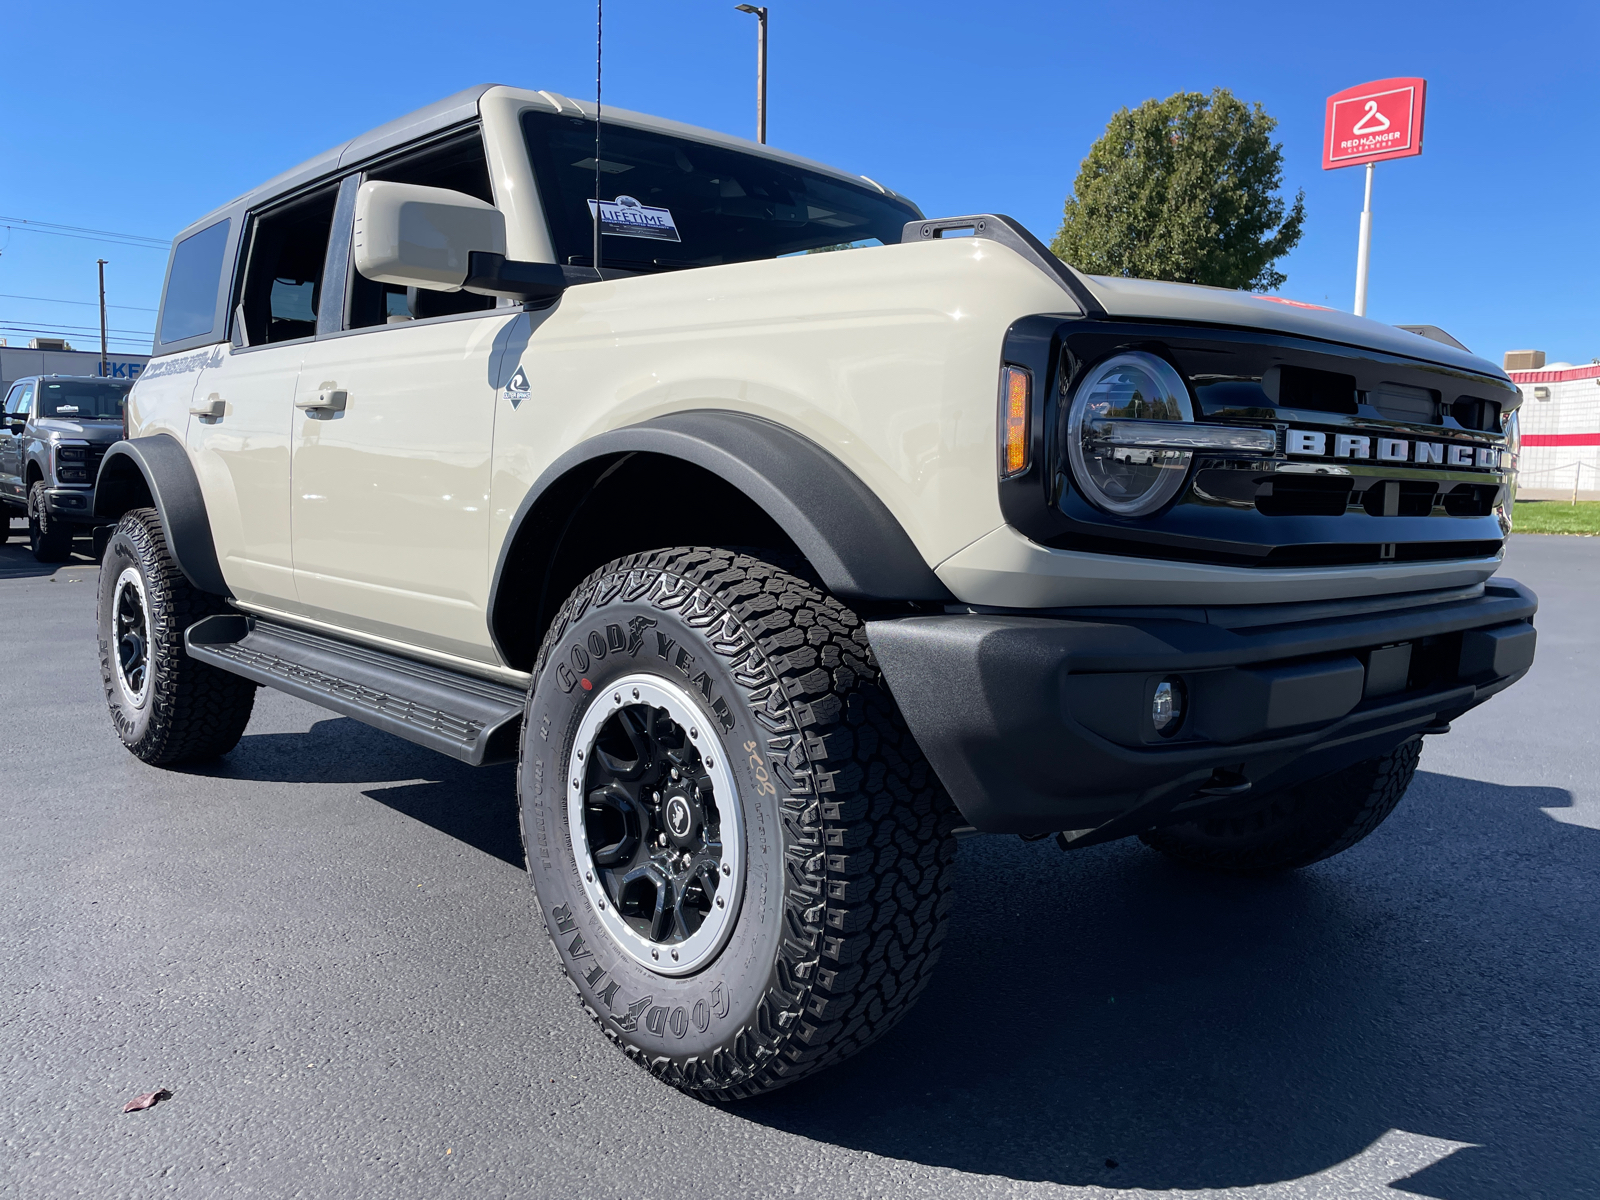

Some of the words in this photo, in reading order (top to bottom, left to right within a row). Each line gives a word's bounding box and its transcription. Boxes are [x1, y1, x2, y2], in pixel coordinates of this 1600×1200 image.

[1341, 139, 1358, 149] RED
[1360, 131, 1400, 145] HANGER
[1347, 141, 1392, 153] CLEANERS
[602, 210, 665, 225] LIFETIME
[1285, 428, 1497, 469] BRONCO
